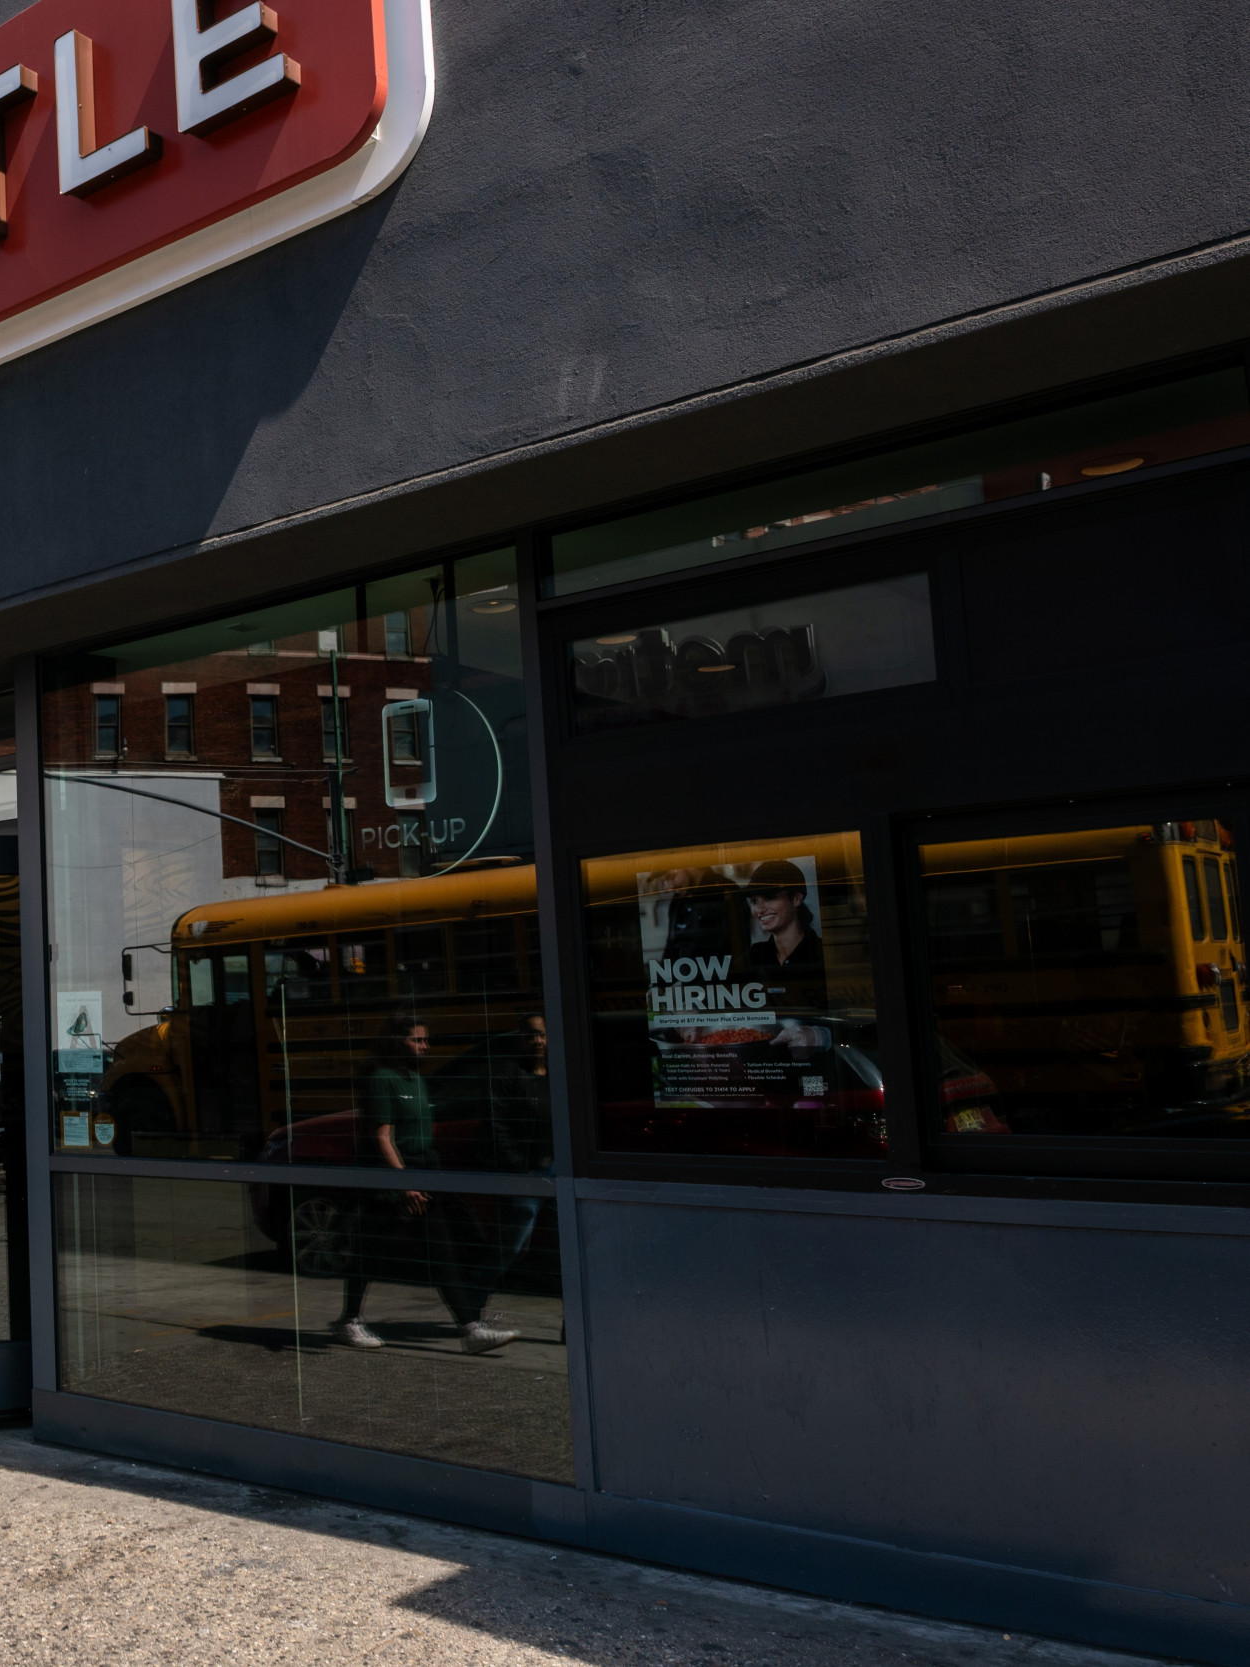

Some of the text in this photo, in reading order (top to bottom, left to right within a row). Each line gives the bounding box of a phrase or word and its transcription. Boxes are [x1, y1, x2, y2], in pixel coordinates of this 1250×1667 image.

[361, 818, 466, 850] PICK-UP
[649, 955, 732, 984] NOW
[651, 982, 767, 1012] HIRING
